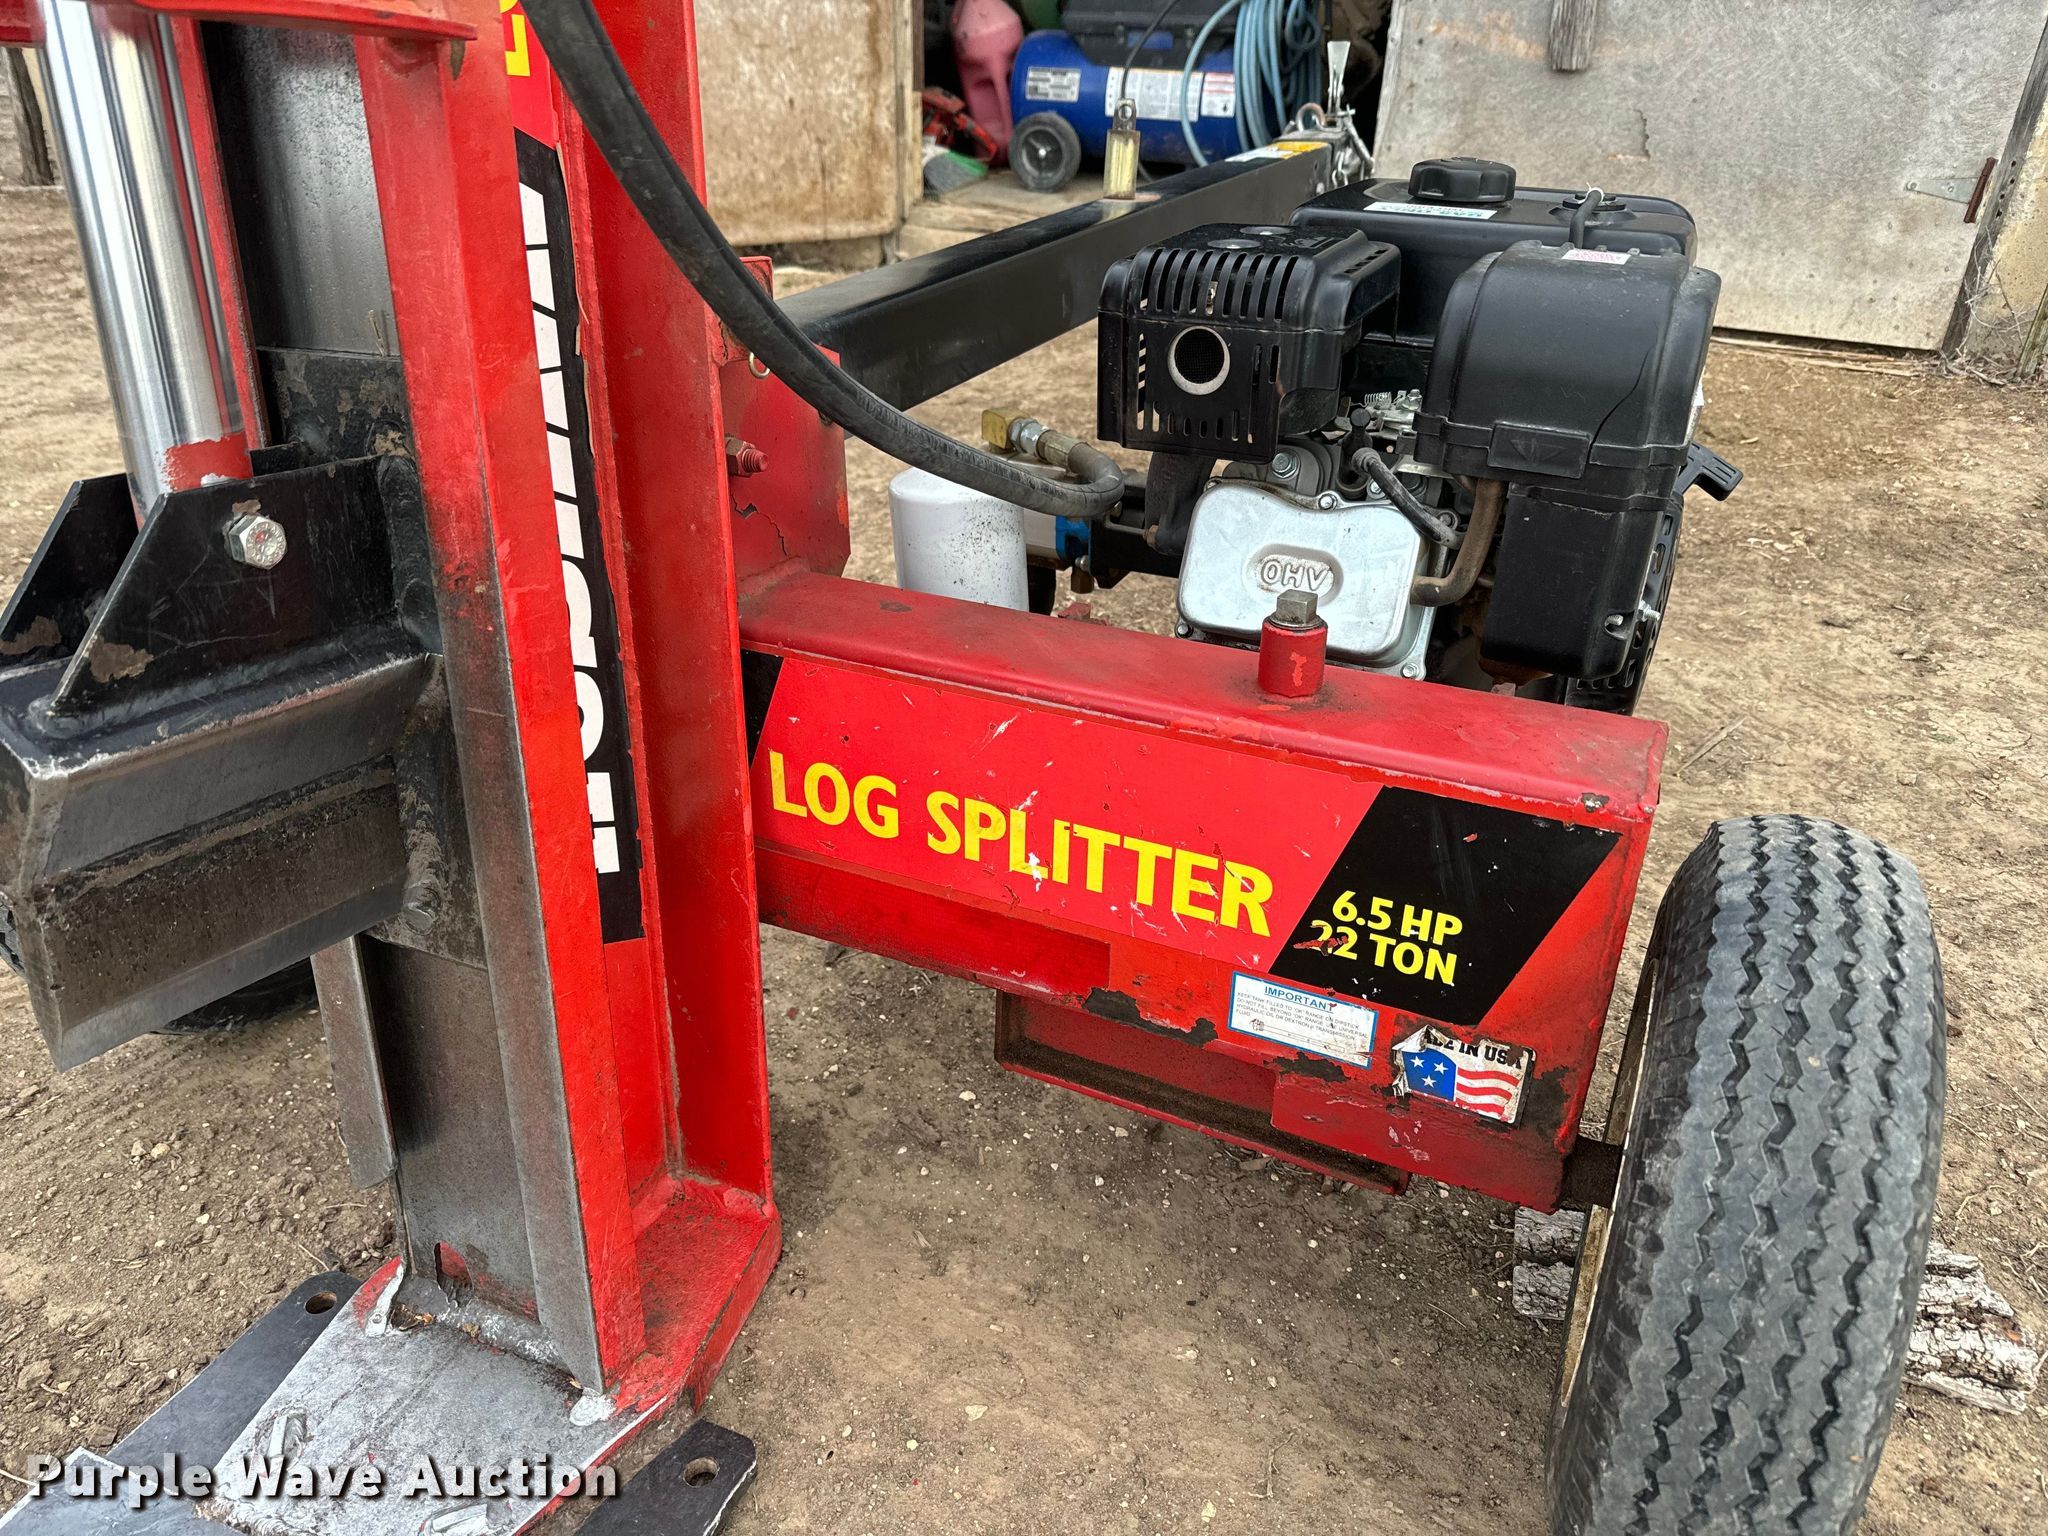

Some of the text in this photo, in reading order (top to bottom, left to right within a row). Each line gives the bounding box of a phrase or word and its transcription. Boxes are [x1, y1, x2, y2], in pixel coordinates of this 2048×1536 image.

[1260, 559, 1330, 592] OHV
[769, 749, 1274, 938] LOG SPLITTER
[1332, 889, 1463, 946] 6.5 HP
[1306, 919, 1457, 987] 22 TON
[1265, 986, 1333, 1011] IMPORTANT
[1305, 1011, 1323, 1020] RANGE
[1237, 1003, 1264, 1015] HYDRAULIC
[1315, 1025, 1355, 1040] TRANSMISSION
[1270, 1007, 1292, 1017] BEYOND
[1339, 1026, 1368, 1038] UNIVERSAL
